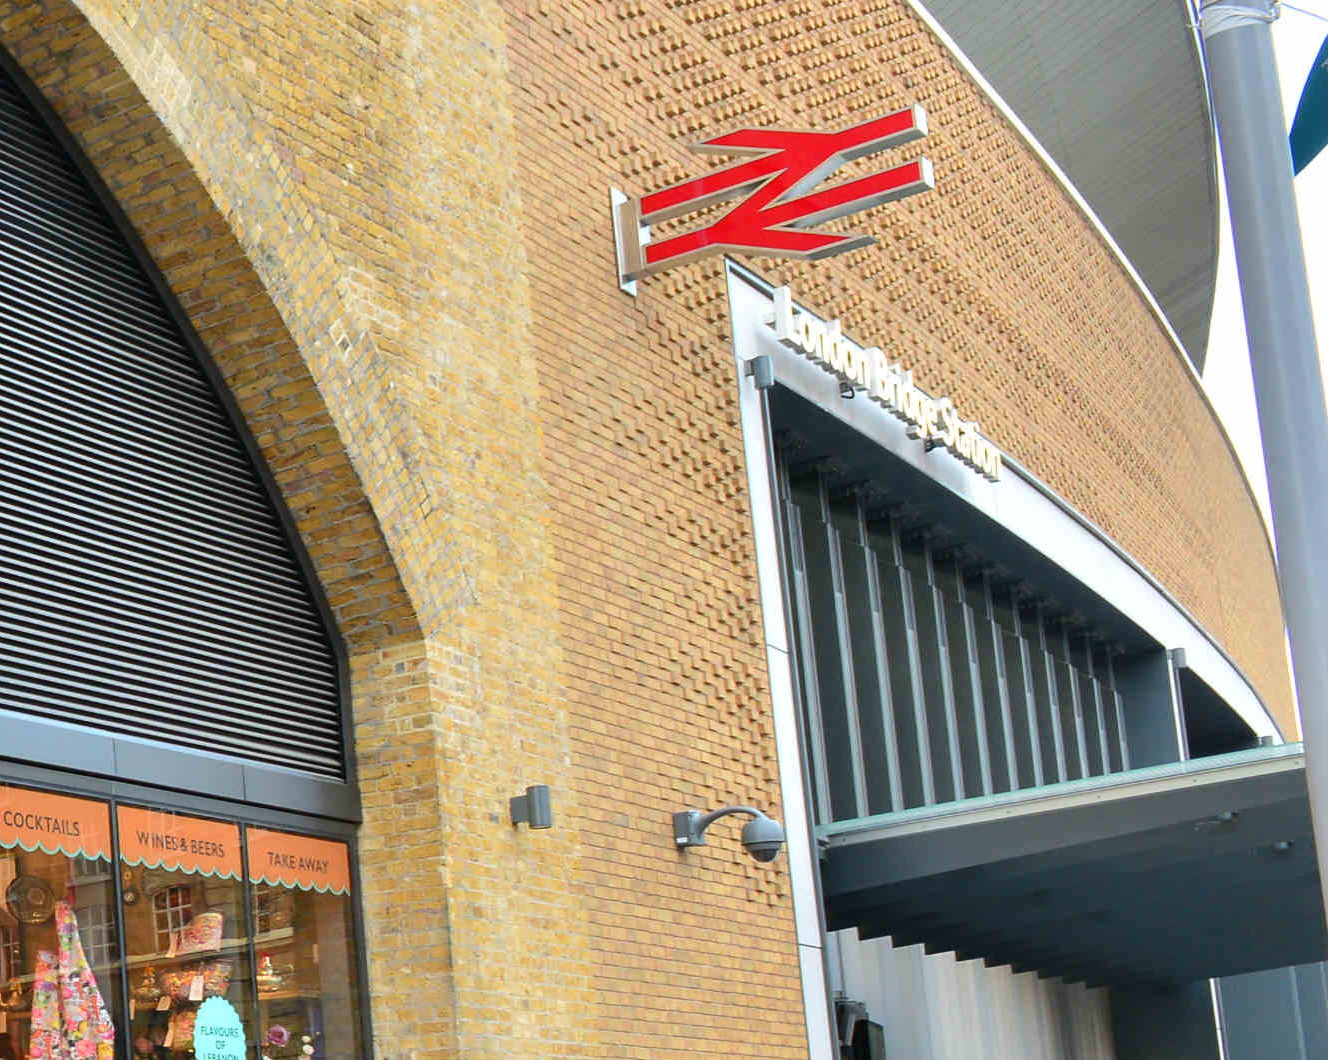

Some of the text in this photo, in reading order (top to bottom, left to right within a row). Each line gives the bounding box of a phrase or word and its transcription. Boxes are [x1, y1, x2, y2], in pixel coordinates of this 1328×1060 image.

[777, 286, 1003, 481] London Bridge Station
[2, 810, 81, 837] COCKTAILS
[135, 830, 225, 858] WINES & BEERS
[266, 851, 330, 873] TAKE AWAY
[200, 1025, 240, 1039] FLAVOURS
[214, 1039, 227, 1050] OF
